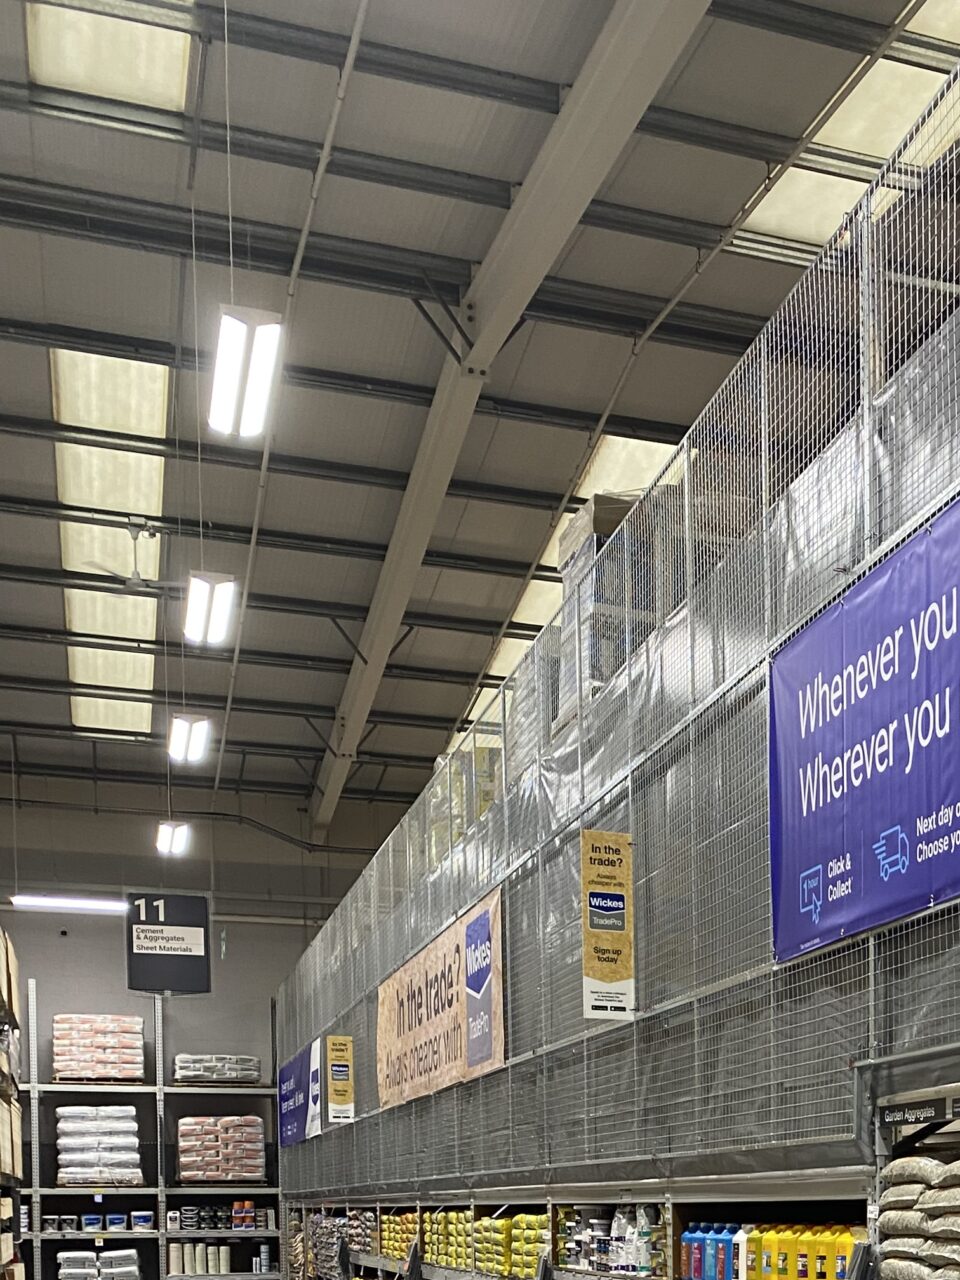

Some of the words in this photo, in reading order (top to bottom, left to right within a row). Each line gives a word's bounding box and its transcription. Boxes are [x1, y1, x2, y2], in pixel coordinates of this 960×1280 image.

[798, 626, 904, 738] Whenever
[910, 585, 958, 679] you
[798, 735, 897, 816] Wherever
[904, 695, 950, 773] you
[916, 814, 936, 837] Next
[938, 804, 954, 826] day
[591, 843, 601, 854] In
[604, 845, 621, 856] the
[916, 837, 949, 863] Choose
[589, 856, 623, 868] trade?
[828, 856, 845, 879] Click
[846, 853, 851, 871] &
[803, 879, 809, 903] 1
[808, 876, 819, 890] hour
[828, 879, 851, 902] Collect
[134, 898, 165, 922] 11
[590, 897, 624, 908] Wickes
[592, 917, 622, 926] TradePro
[143, 934, 185, 942] Aggregates
[159, 945, 193, 953] Materials
[466, 939, 491, 977] Wickes
[593, 946, 611, 955] Sign
[597, 956, 618, 964] today
[396, 988, 404, 1039] In
[407, 978, 423, 1033] the
[425, 943, 461, 1022] trade?
[469, 1011, 489, 1040] TradePro
[444, 1012, 463, 1066] with
[885, 1110, 903, 1122] Garden
[904, 1106, 935, 1122] Aggregates
